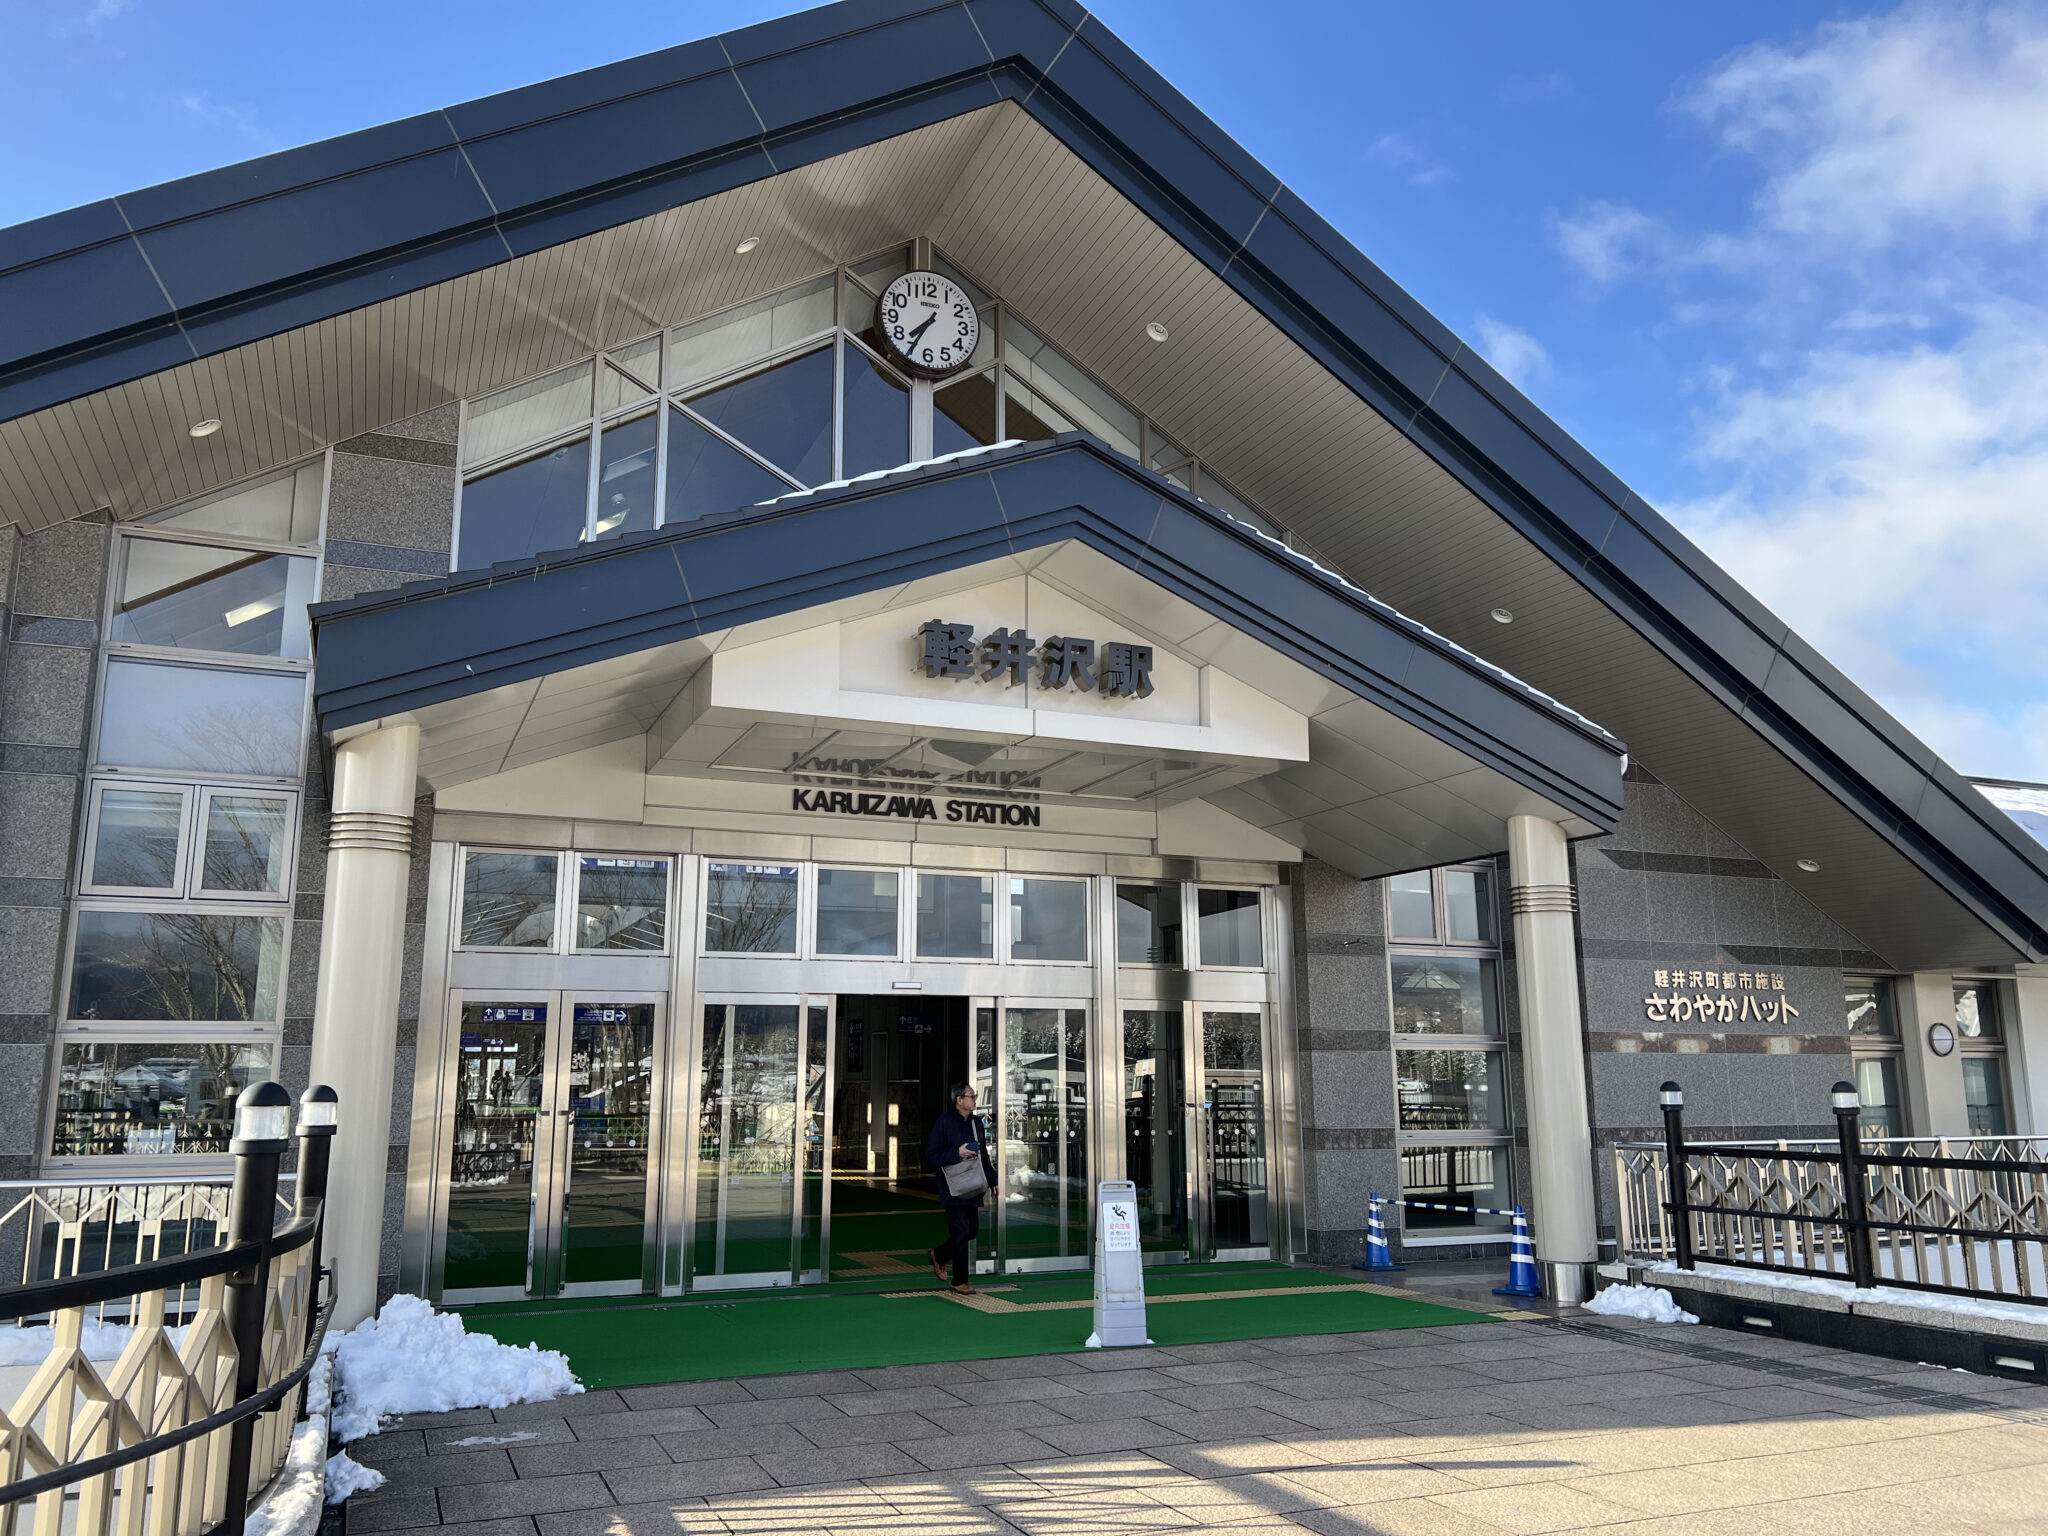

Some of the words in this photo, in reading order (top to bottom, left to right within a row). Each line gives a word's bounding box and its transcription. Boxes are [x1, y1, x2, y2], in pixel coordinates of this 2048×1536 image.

[907, 282, 919, 298] 11
[922, 282, 937, 298] 12
[944, 289, 949, 304] 1
[892, 292, 907, 308] 10
[920, 301, 940, 309] SEIKO
[887, 308, 899, 323] 9
[953, 303, 964, 318] 2
[893, 325, 905, 340] 8
[957, 321, 969, 336] 3
[952, 337, 964, 351] 4
[922, 348, 934, 363] 6
[940, 347, 951, 361] 5
[918, 618, 1154, 699] 軽井沢駅
[792, 788, 938, 820] KARUIZAWA
[946, 799, 1041, 827] STATION
[1653, 969, 1785, 991] 軽井沢町都市施設
[1645, 992, 1799, 1024] さわやかハット
